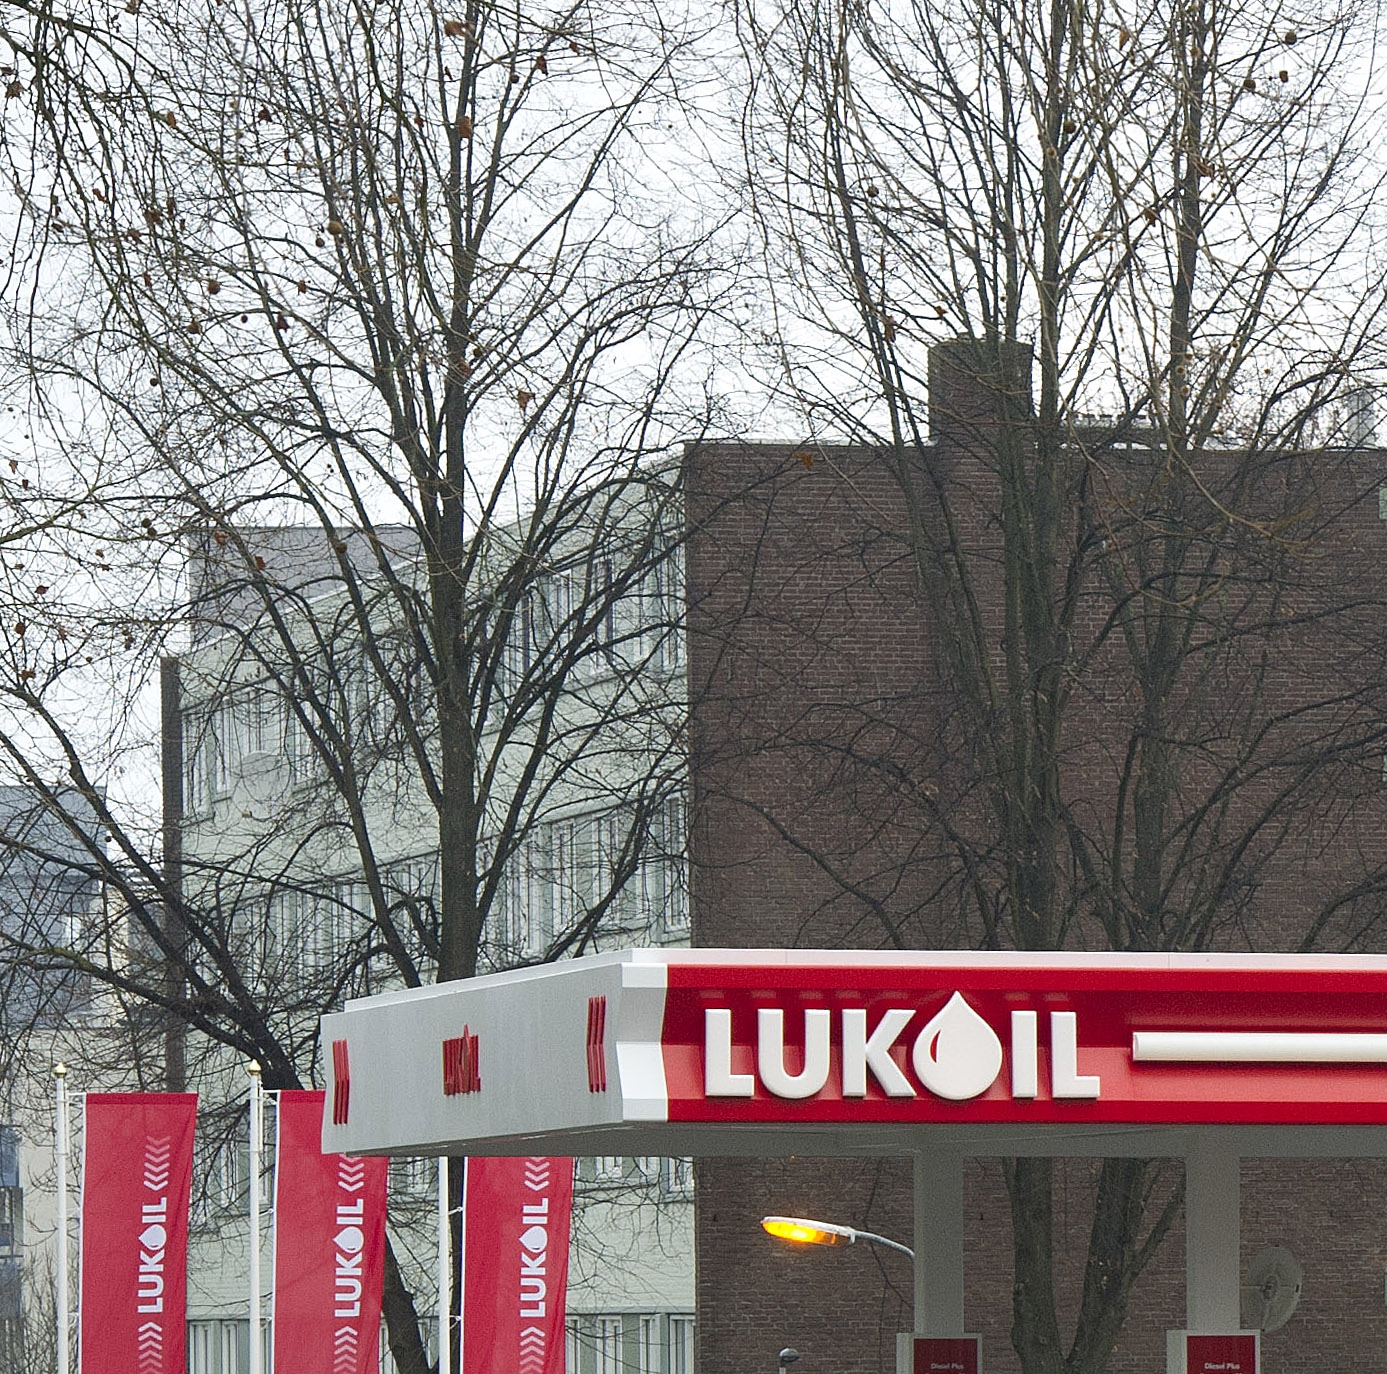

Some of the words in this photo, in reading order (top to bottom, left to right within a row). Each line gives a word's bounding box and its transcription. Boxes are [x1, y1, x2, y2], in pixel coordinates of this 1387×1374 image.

[705, 990, 1100, 1099] LUKOIL
[138, 1197, 166, 1313] LUKOIL
[333, 1198, 363, 1317] LUKOIL
[519, 1198, 548, 1317] LUKOIL
